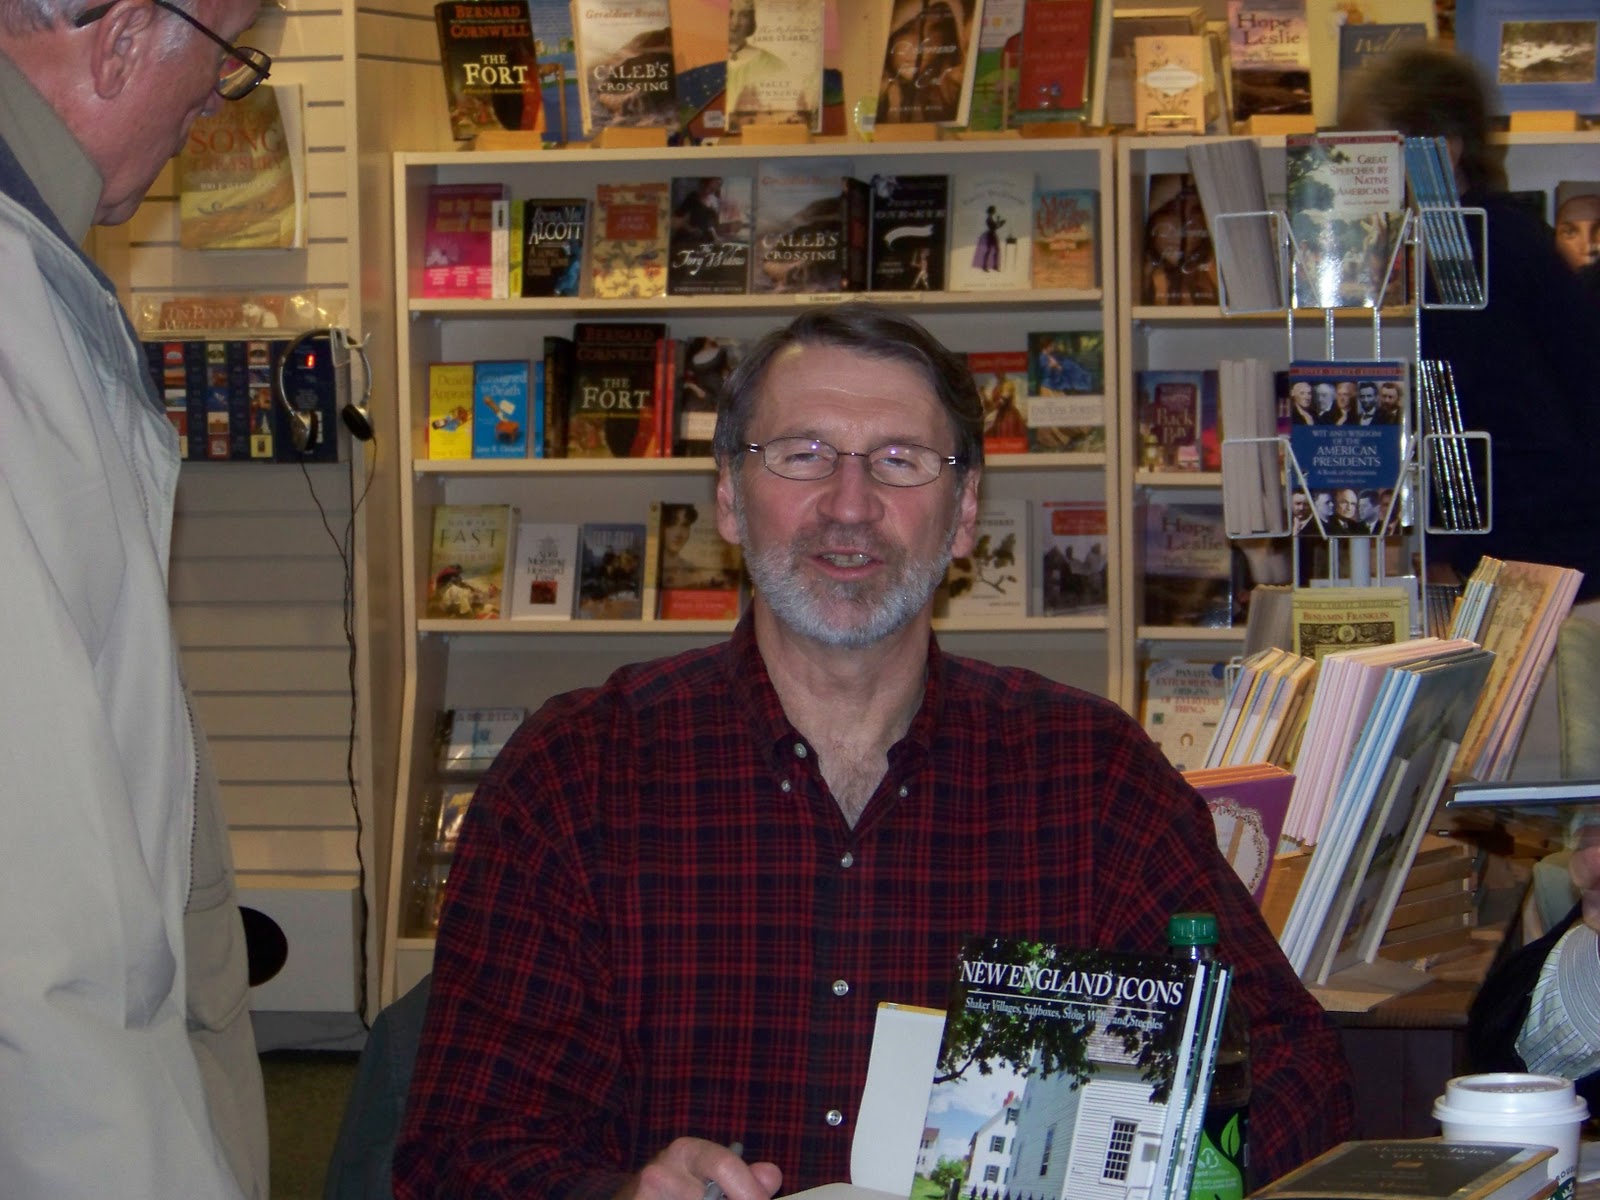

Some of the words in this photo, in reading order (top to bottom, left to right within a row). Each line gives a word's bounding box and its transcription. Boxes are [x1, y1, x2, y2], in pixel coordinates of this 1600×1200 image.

[455, 5, 521, 19] BERNARD
[1237, 14, 1292, 31] Hope
[450, 25, 530, 38] CORNWELL
[1243, 30, 1300, 46] Leslie
[481, 54, 507, 65] THE
[464, 63, 528, 85] FORT
[593, 62, 669, 80] CALEB'S
[599, 81, 668, 92] CROSSING
[1357, 154, 1388, 165] GREAT
[1330, 165, 1374, 175] SPEECHES
[1377, 165, 1388, 174] BY
[1354, 174, 1389, 184] NATIVE
[1337, 186, 1389, 196] AMERICANS
[528, 221, 583, 245] ALCOTT
[762, 230, 839, 248] CALEB'S
[764, 250, 836, 261] CROSSING
[602, 377, 630, 388] THE
[581, 386, 651, 409] FORT
[1156, 407, 1193, 426] Back
[1316, 445, 1376, 456] AMERICAN
[1313, 457, 1381, 467] PRESIDENTS
[1162, 516, 1216, 536] Hope
[439, 527, 496, 548] FAST
[1303, 612, 1342, 621] BENJAMIN
[1346, 611, 1389, 620] FRANKLIN
[960, 960, 1007, 986] NEW
[1007, 966, 1112, 998] ENGLAND
[1115, 976, 1183, 1005] ICONS
[965, 997, 991, 1012] Shaker
[992, 1000, 1022, 1014] Villages,
[1023, 1003, 1061, 1019] Saltboxes,
[1062, 1006, 1086, 1021] Stone
[1112, 1014, 1128, 1025] and
[1129, 1016, 1164, 1030] Steeples
